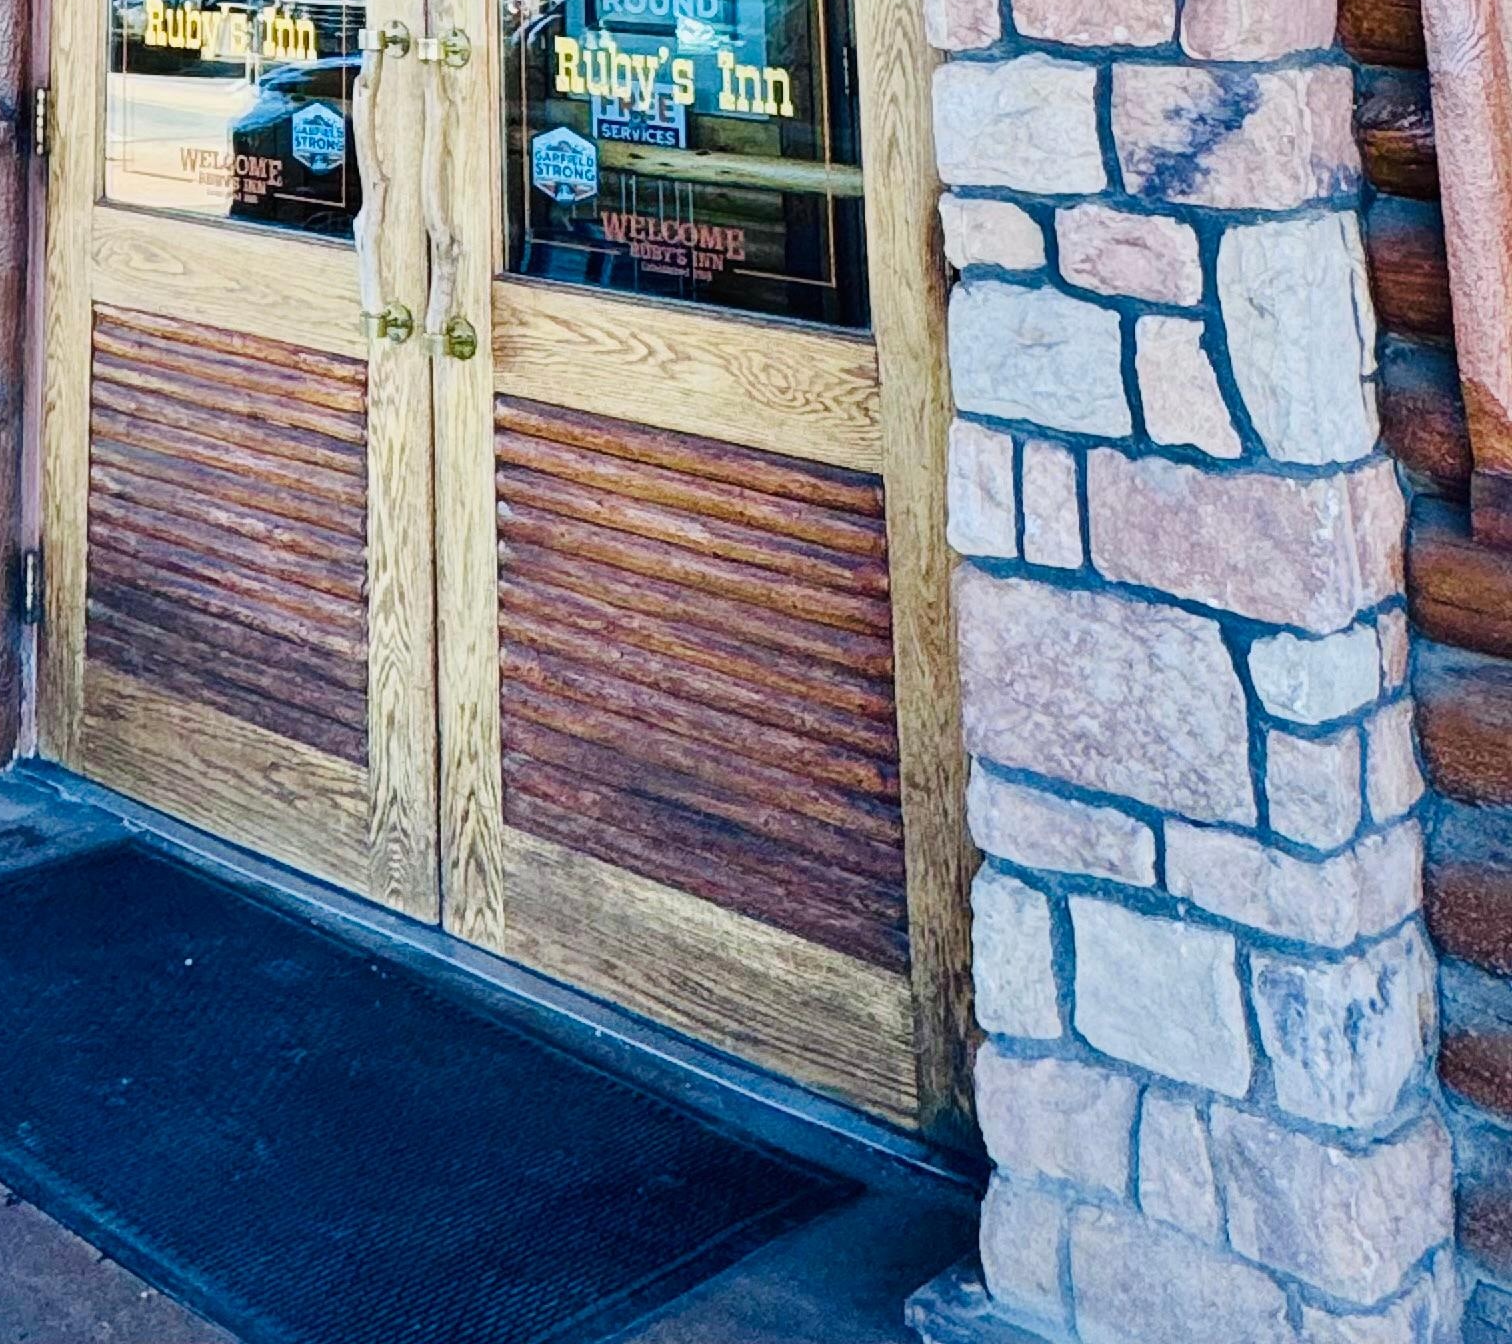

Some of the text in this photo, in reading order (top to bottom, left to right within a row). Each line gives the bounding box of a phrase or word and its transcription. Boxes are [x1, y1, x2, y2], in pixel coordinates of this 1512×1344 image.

[262, 6, 318, 62] Inn
[554, 35, 794, 118] Ruby's Inn
[601, 123, 677, 146] SERVICES
[179, 147, 284, 188] WELCOME
[535, 161, 595, 181] STRONG
[600, 210, 746, 262] WELCOME
